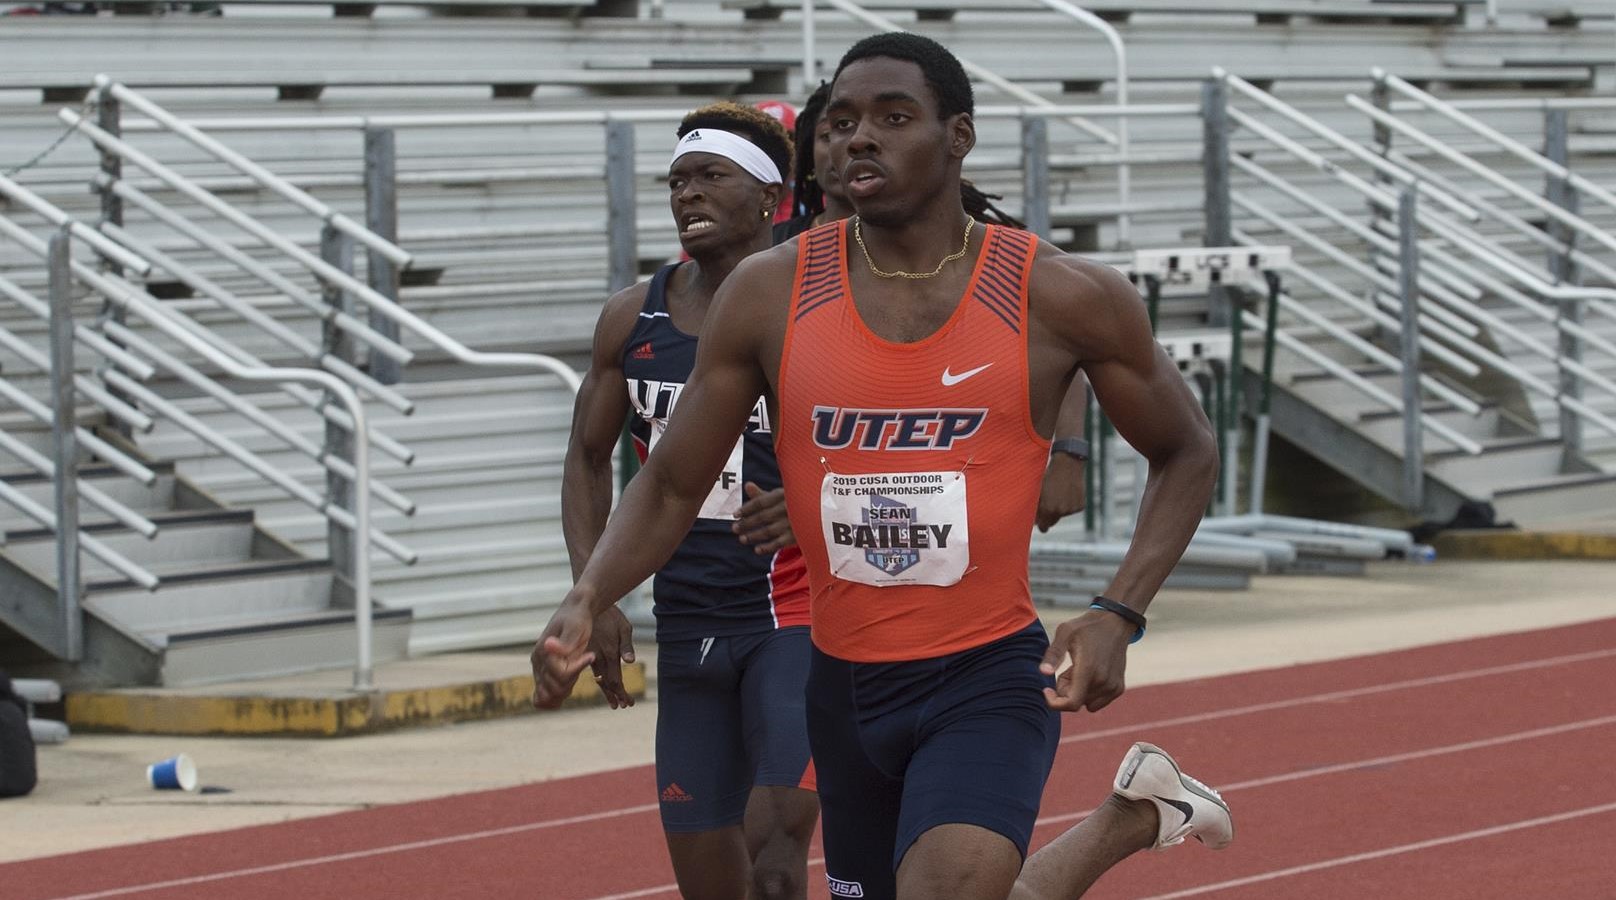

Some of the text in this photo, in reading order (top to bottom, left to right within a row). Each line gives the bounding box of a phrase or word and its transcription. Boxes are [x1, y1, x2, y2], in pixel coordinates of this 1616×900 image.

[811, 405, 989, 450] UTEP
[833, 475, 942, 486] 2019 CUSA OUTDOOR
[833, 486, 944, 496] T&F CHAMPIONSHIPS
[869, 508, 911, 520] SEAN
[832, 521, 952, 549] BAILEY
